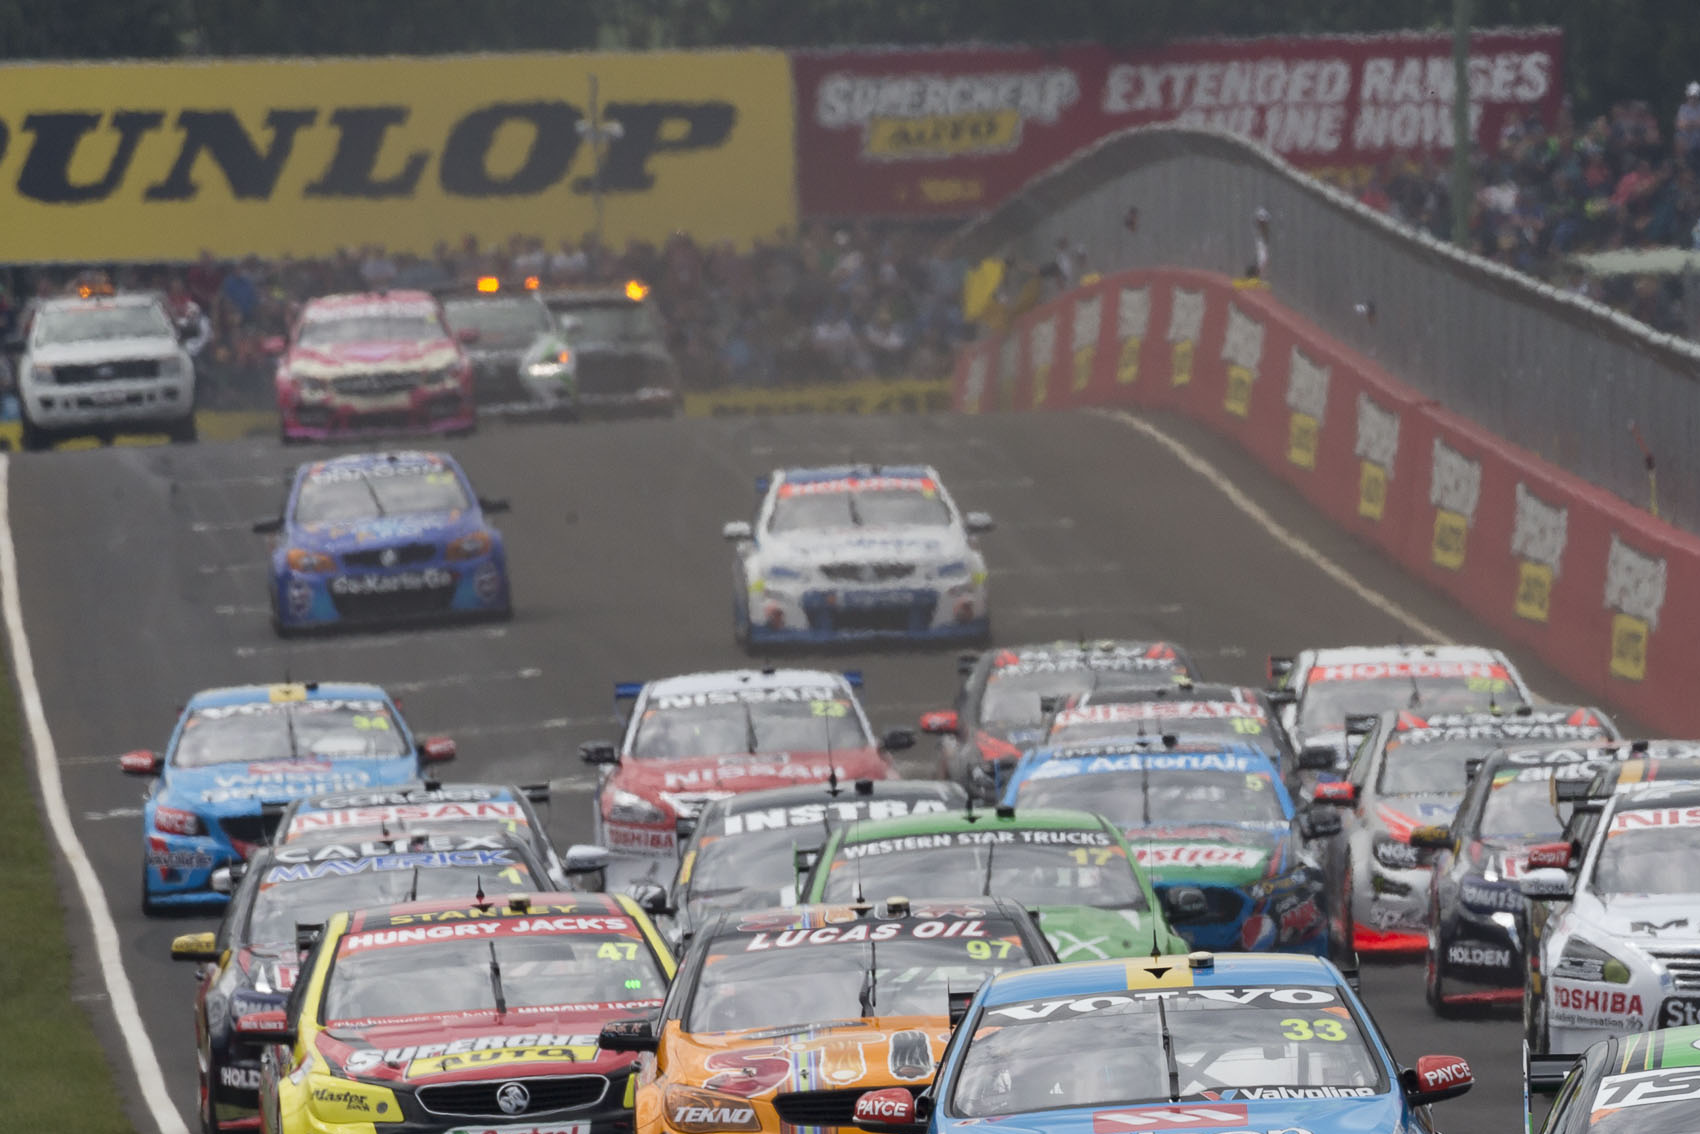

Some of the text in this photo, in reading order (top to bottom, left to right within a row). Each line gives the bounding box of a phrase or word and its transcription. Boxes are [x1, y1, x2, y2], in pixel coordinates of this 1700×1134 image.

[1103, 60, 1351, 112] EXTENDED
[818, 70, 1079, 128] SUPERCHEAP
[0, 100, 738, 204] UNLOP
[658, 685, 834, 711] NISSAN
[1062, 700, 1259, 723] NISSAN
[664, 763, 846, 788] NISSAN
[296, 803, 516, 828] NISSAN
[275, 836, 502, 864] CALTEX
[844, 830, 1111, 858] WESTERN STAR TRUCKS
[266, 849, 513, 883] MAVERICK
[1069, 848, 1113, 867] 17
[390, 904, 578, 926] STANLEY
[347, 922, 501, 949] HUNGRY
[746, 923, 903, 951] LUCAS
[912, 920, 986, 940] OIL
[597, 941, 639, 962] 47
[966, 940, 1009, 960] 97
[1448, 945, 1511, 968] HOLDEN
[987, 988, 1336, 1021] VOLVO
[1553, 982, 1644, 1017] TOSHIBA
[1283, 1018, 1348, 1042] 33
[344, 1034, 602, 1071] SUPERCHE
[435, 1048, 576, 1070] AUTO
[1424, 1062, 1473, 1087] PAYCE
[1241, 1086, 1376, 1101] Valvoline
[672, 1105, 755, 1125] TEKNO
[857, 1097, 909, 1118] PAYCE
